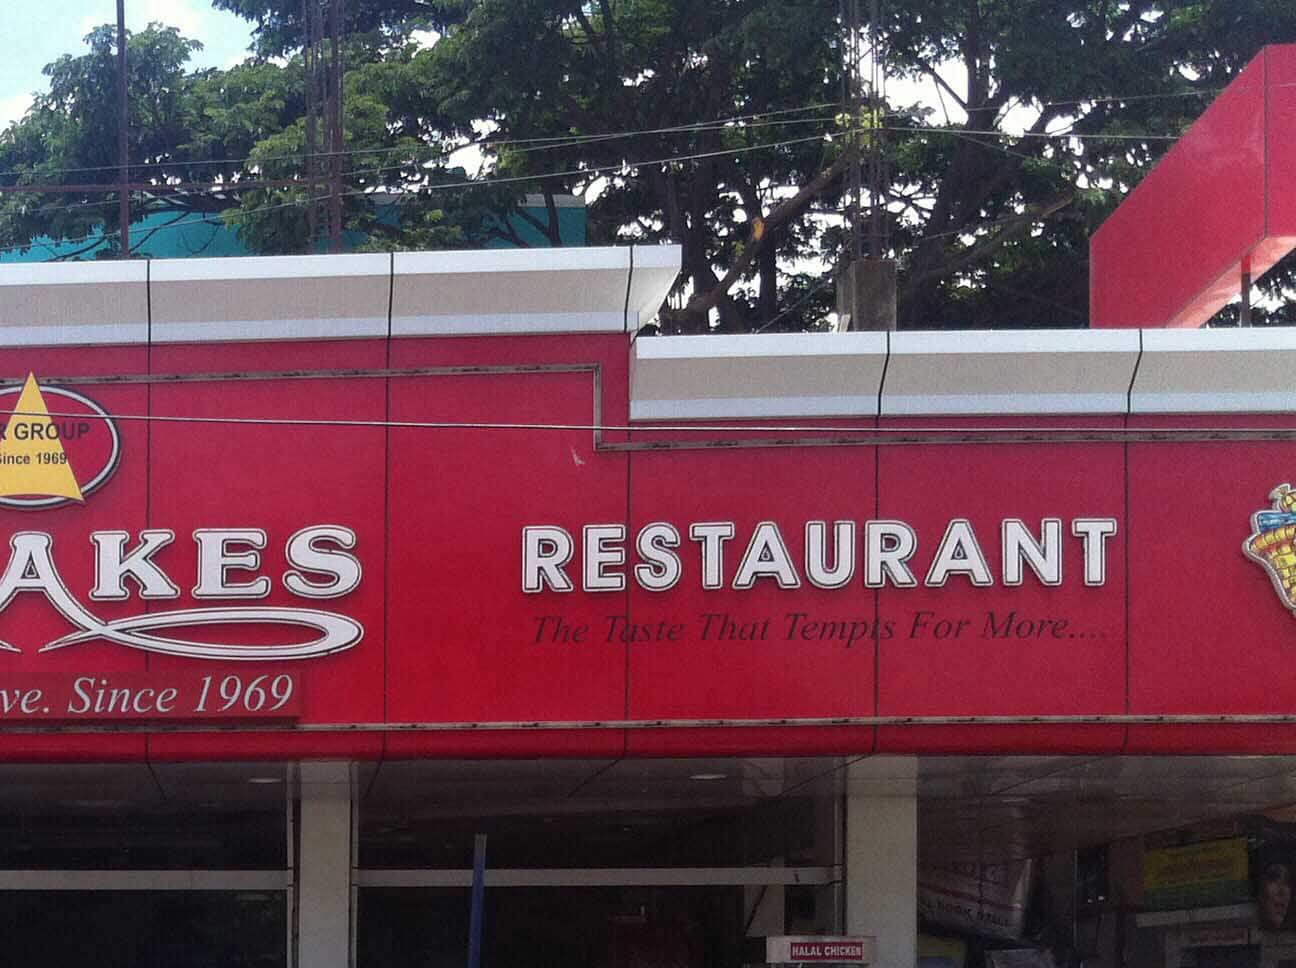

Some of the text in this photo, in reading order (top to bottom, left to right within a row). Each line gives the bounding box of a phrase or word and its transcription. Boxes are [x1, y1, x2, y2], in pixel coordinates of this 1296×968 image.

[13, 422, 91, 440] GROUP
[36, 451, 68, 465] 1969
[521, 517, 1118, 594] RESTAURANT
[533, 615, 590, 643] The
[607, 614, 684, 642] Taste
[700, 613, 771, 641] That
[784, 612, 897, 650] Tempts
[909, 610, 971, 640] For
[67, 675, 178, 713] Since
[193, 673, 295, 712] 1969
[792, 944, 861, 957] HALAL CHICKEN
